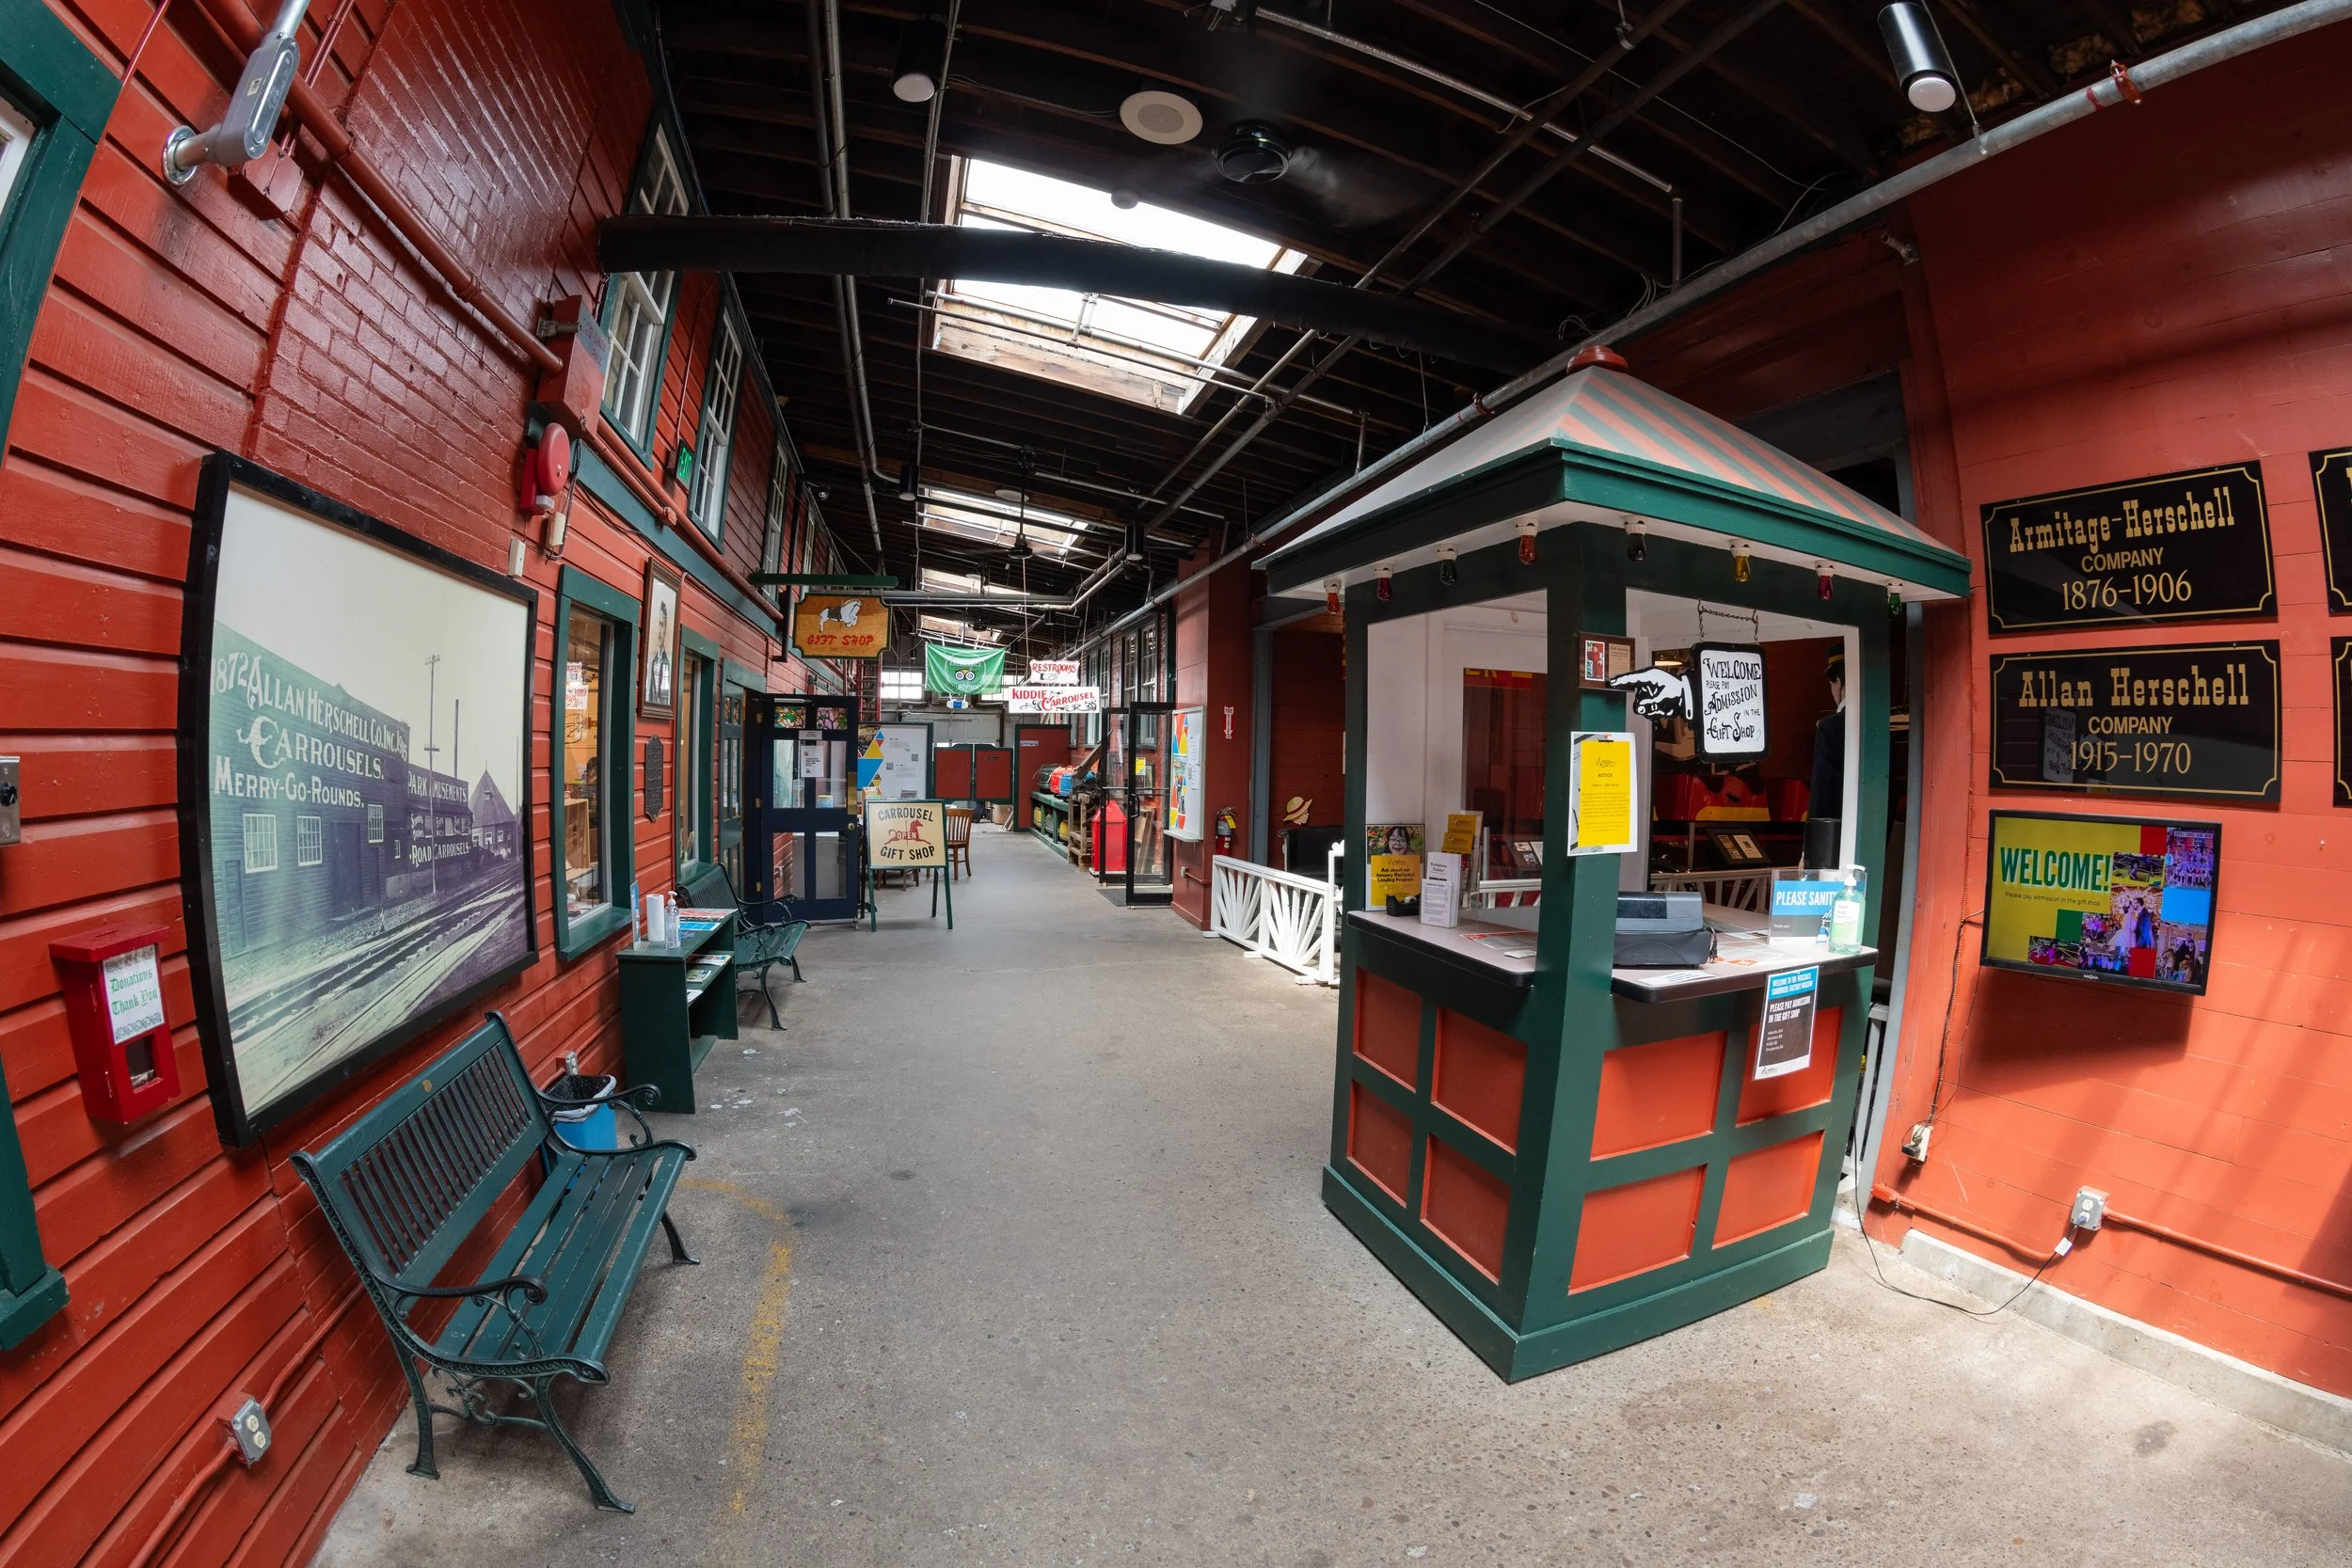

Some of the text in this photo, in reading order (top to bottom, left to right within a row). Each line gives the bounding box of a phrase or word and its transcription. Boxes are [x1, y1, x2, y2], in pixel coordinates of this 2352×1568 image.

[2010, 485, 2235, 554] Armitage-Herschell
[2081, 546, 2164, 573] COMPANY
[2061, 569, 2192, 611] 1876-1906
[806, 634, 875, 646] GIFT SHOP
[1031, 662, 1077, 673] RESTROOMS
[1703, 657, 1761, 680] WELCOME
[1706, 680, 1730, 690] PLEASE PAY
[2018, 663, 2249, 707] Allan Herschell
[246, 655, 306, 719] ALLAN
[307, 687, 370, 747] HERSCHELL
[1011, 689, 1095, 711] KIDDIE CARROUSEL
[1704, 684, 1757, 716] ADMISSION
[1706, 712, 1756, 742] GIFT SHOP
[2088, 716, 2172, 735] COMPANY
[2071, 740, 2191, 775] 1915-1970
[407, 770, 428, 798] PARK
[878, 807, 933, 822] CARROUSEL
[897, 831, 916, 840] OPEN
[881, 845, 935, 861] GIFT SHOP
[2000, 847, 2112, 892] WELCOME!
[1775, 891, 1807, 906] PLEASE
[2033, 895, 2060, 903] admission
[110, 968, 153, 993] Donations
[112, 989, 158, 1015] Thank You
[1770, 1002, 1785, 1013] PLEASE
[1785, 1000, 1793, 1009] PAY
[1769, 1015, 1774, 1023] IN
[1782, 1011, 1791, 1021] GIFT
[1790, 1008, 1801, 1019] SHOP
